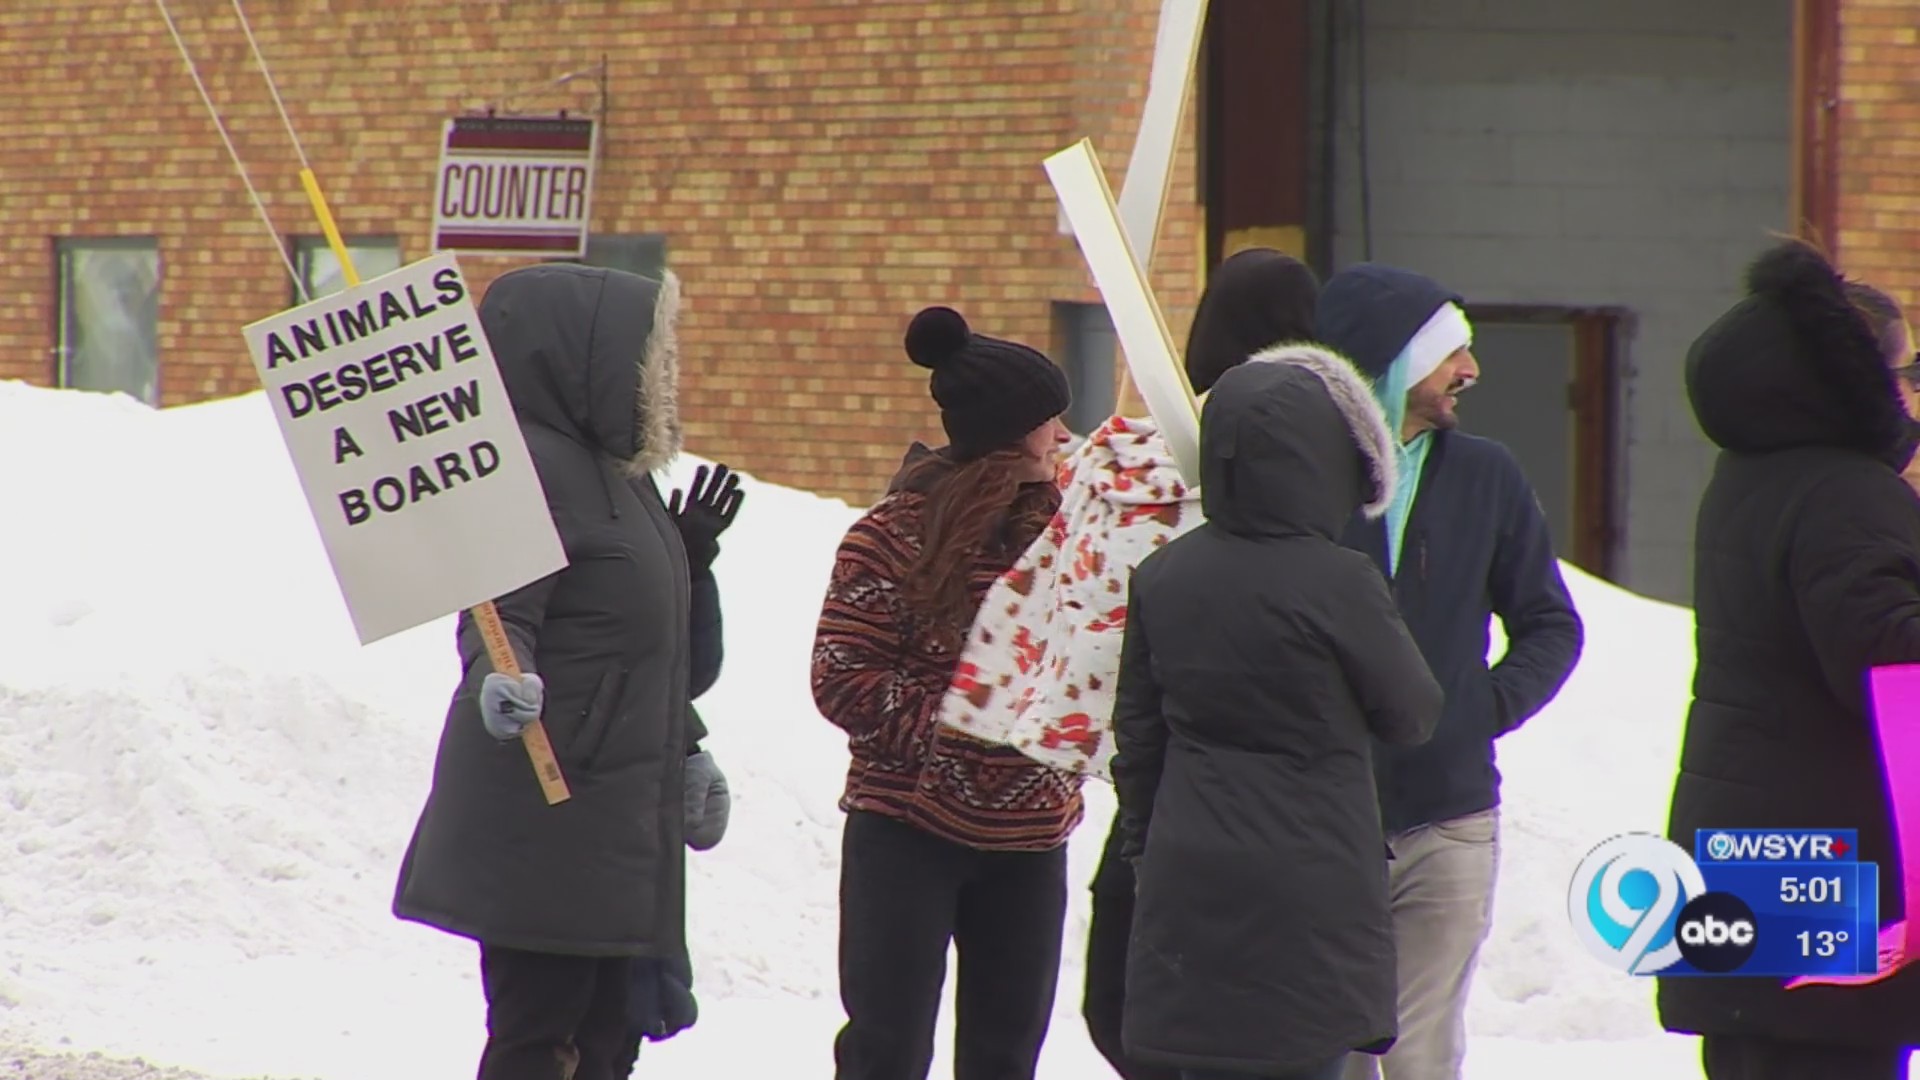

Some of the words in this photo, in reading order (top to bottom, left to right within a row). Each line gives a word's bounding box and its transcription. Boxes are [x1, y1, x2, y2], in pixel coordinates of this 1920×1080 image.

[440, 163, 586, 219] COUNTER
[266, 268, 465, 369] ANIMALS
[281, 323, 479, 418] DESERVE
[334, 426, 364, 464] A
[387, 379, 481, 443] NEW
[338, 440, 500, 525] BOARD
